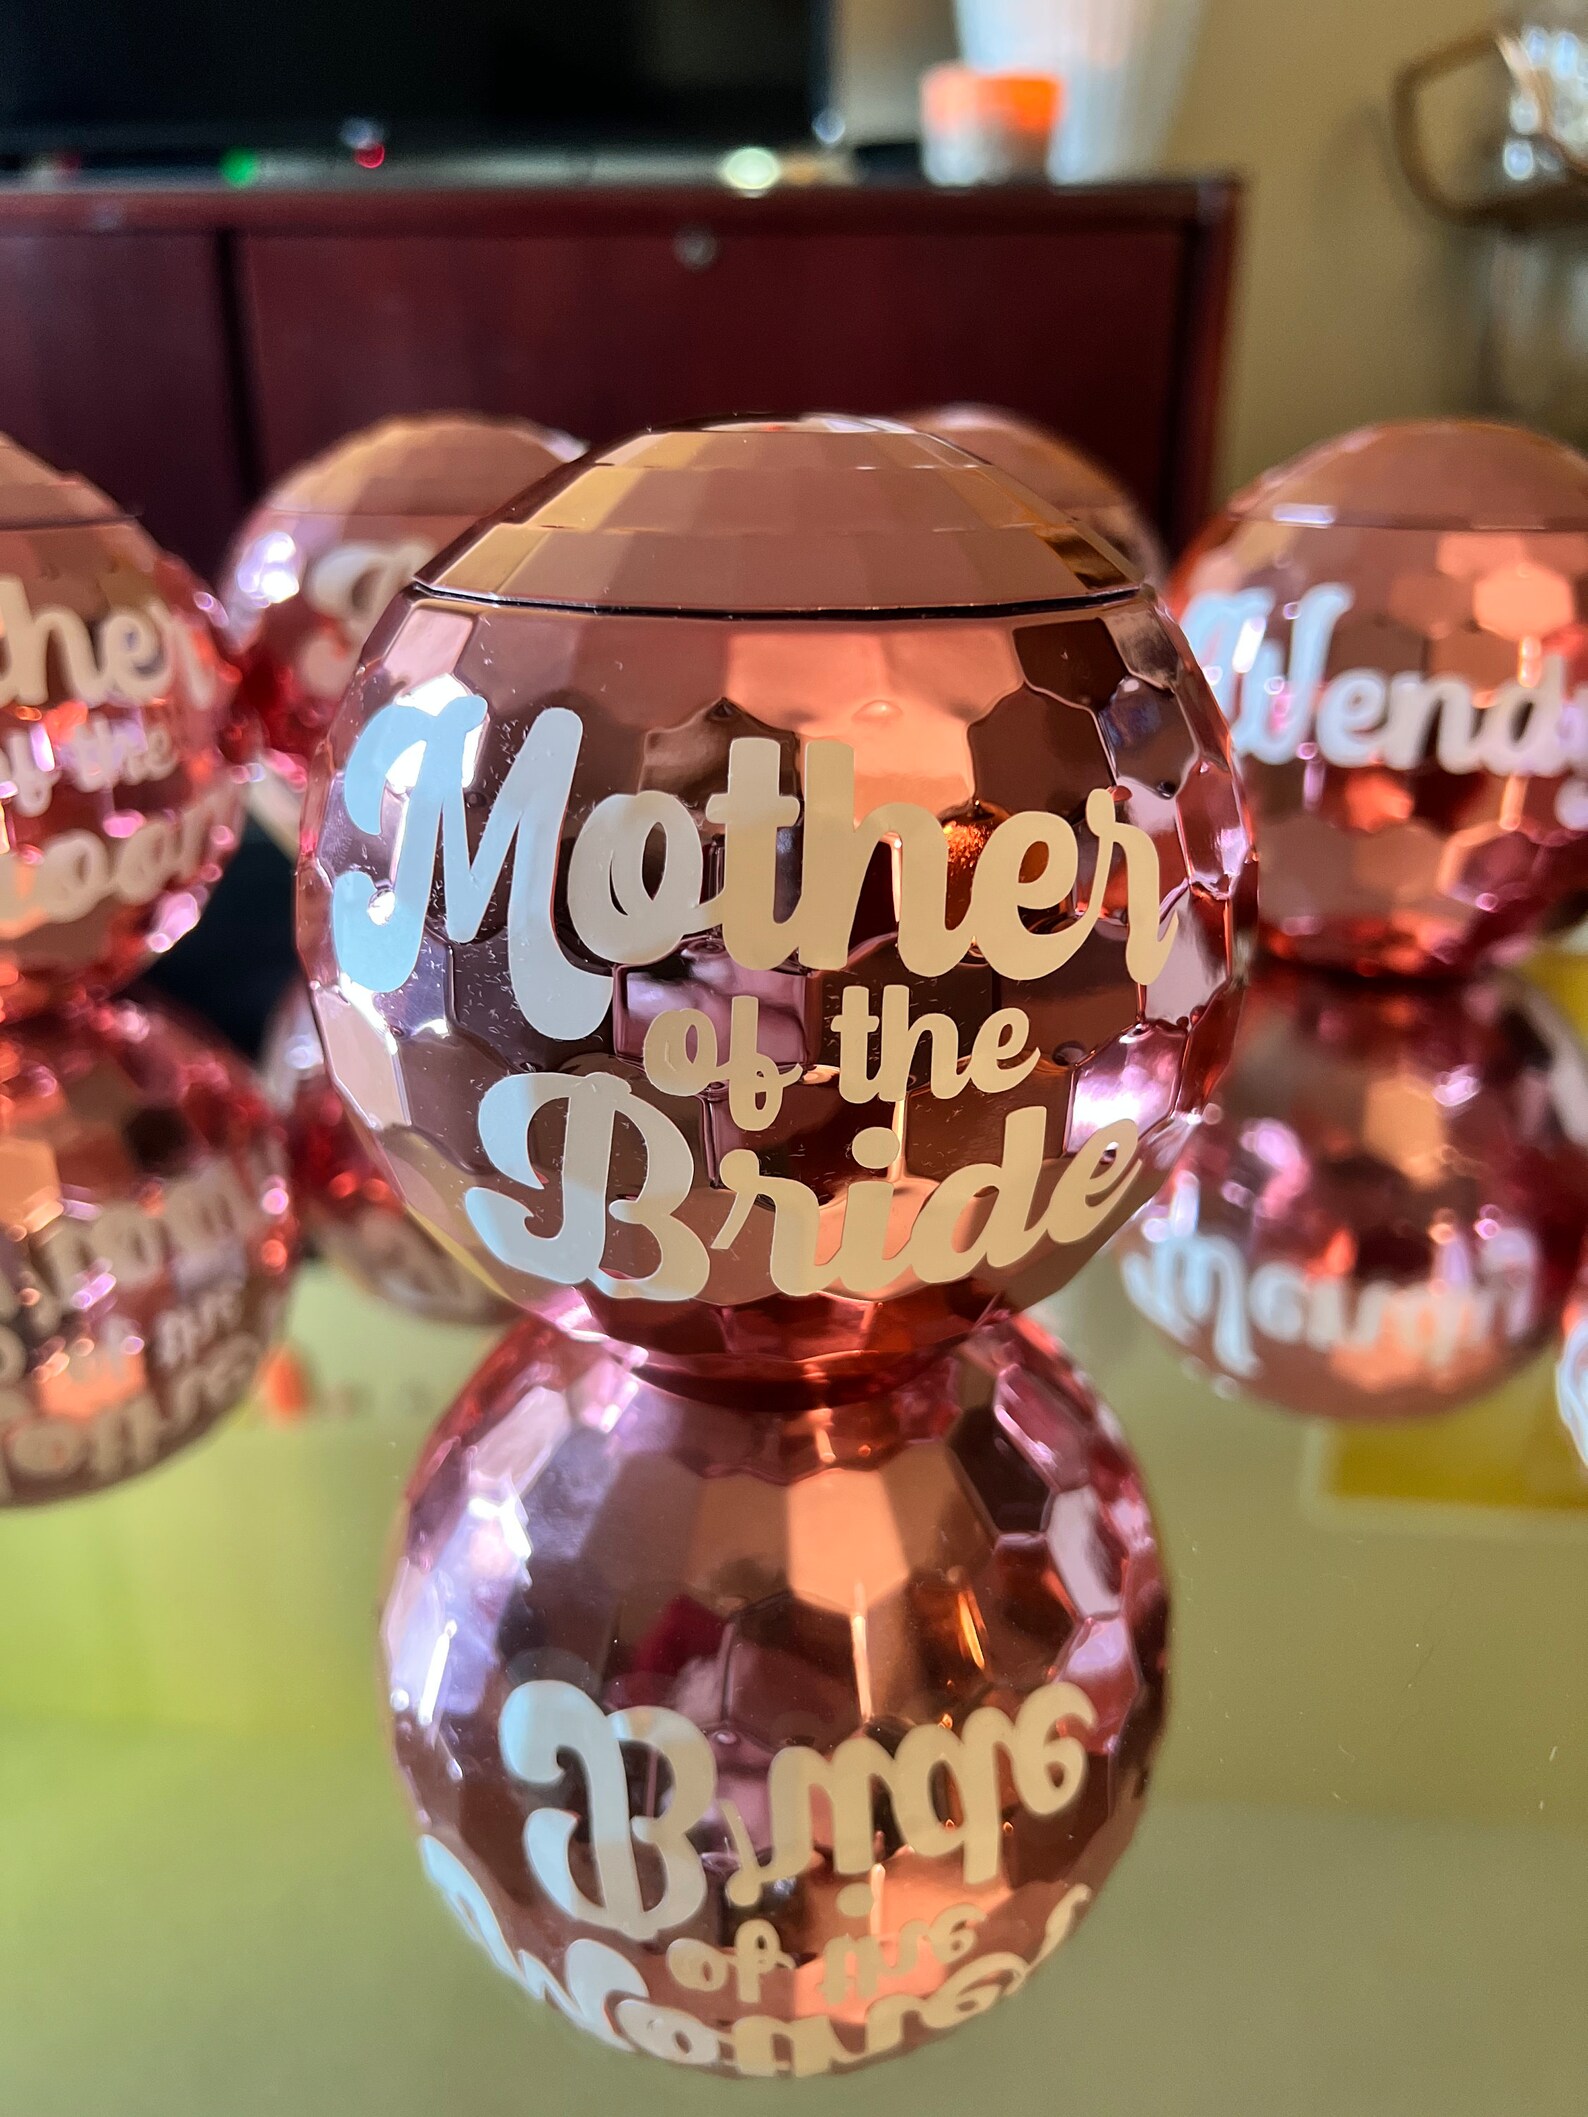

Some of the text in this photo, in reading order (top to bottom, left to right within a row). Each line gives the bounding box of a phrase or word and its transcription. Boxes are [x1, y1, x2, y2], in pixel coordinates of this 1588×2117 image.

[333, 696, 1179, 1041] Mother
[643, 984, 1041, 1132] of the
[463, 1071, 1142, 1302] Bride
